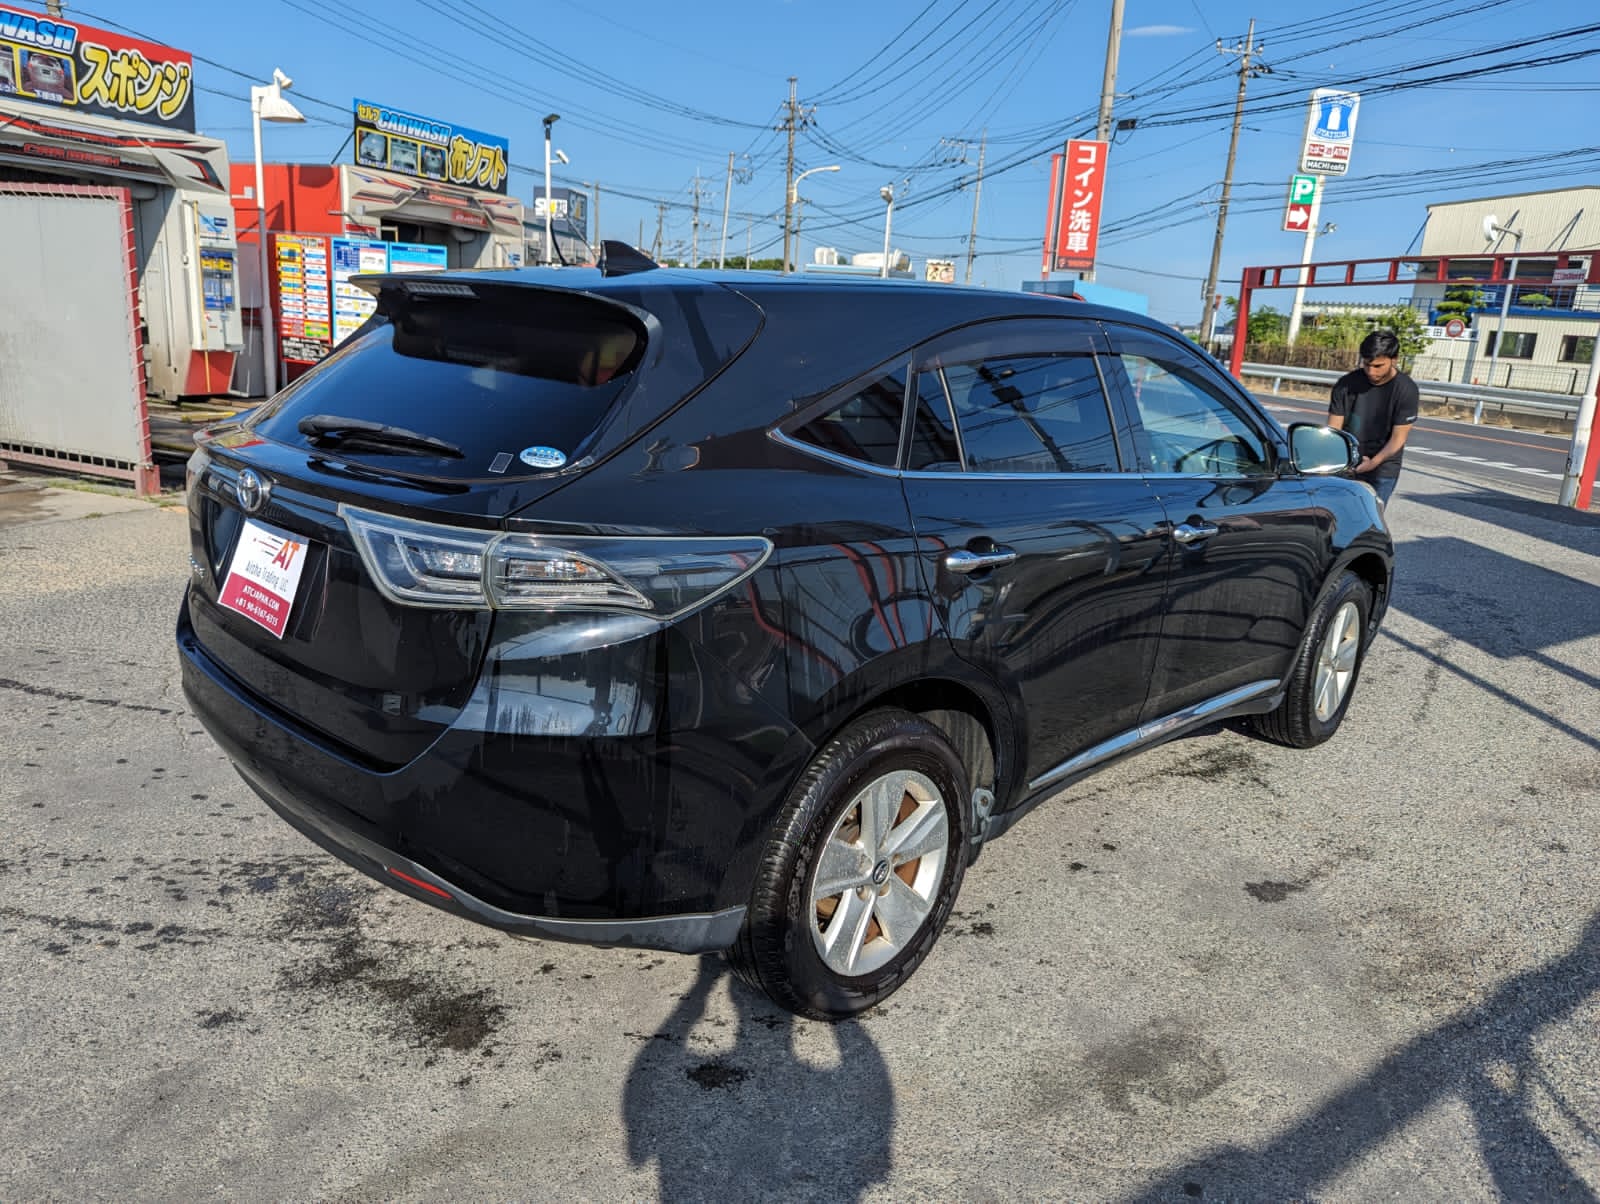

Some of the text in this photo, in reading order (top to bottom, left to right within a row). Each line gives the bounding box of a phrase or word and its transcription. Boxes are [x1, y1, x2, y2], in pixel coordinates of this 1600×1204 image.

[80, 46, 190, 117] スポンジ
[378, 110, 450, 144] CARWASH
[450, 137, 506, 187] 布ソフト
[1307, 160, 1330, 170] MACHI
[1065, 144, 1097, 253] コイン洗車
[1293, 178, 1314, 201] P
[271, 538, 300, 572] AT
